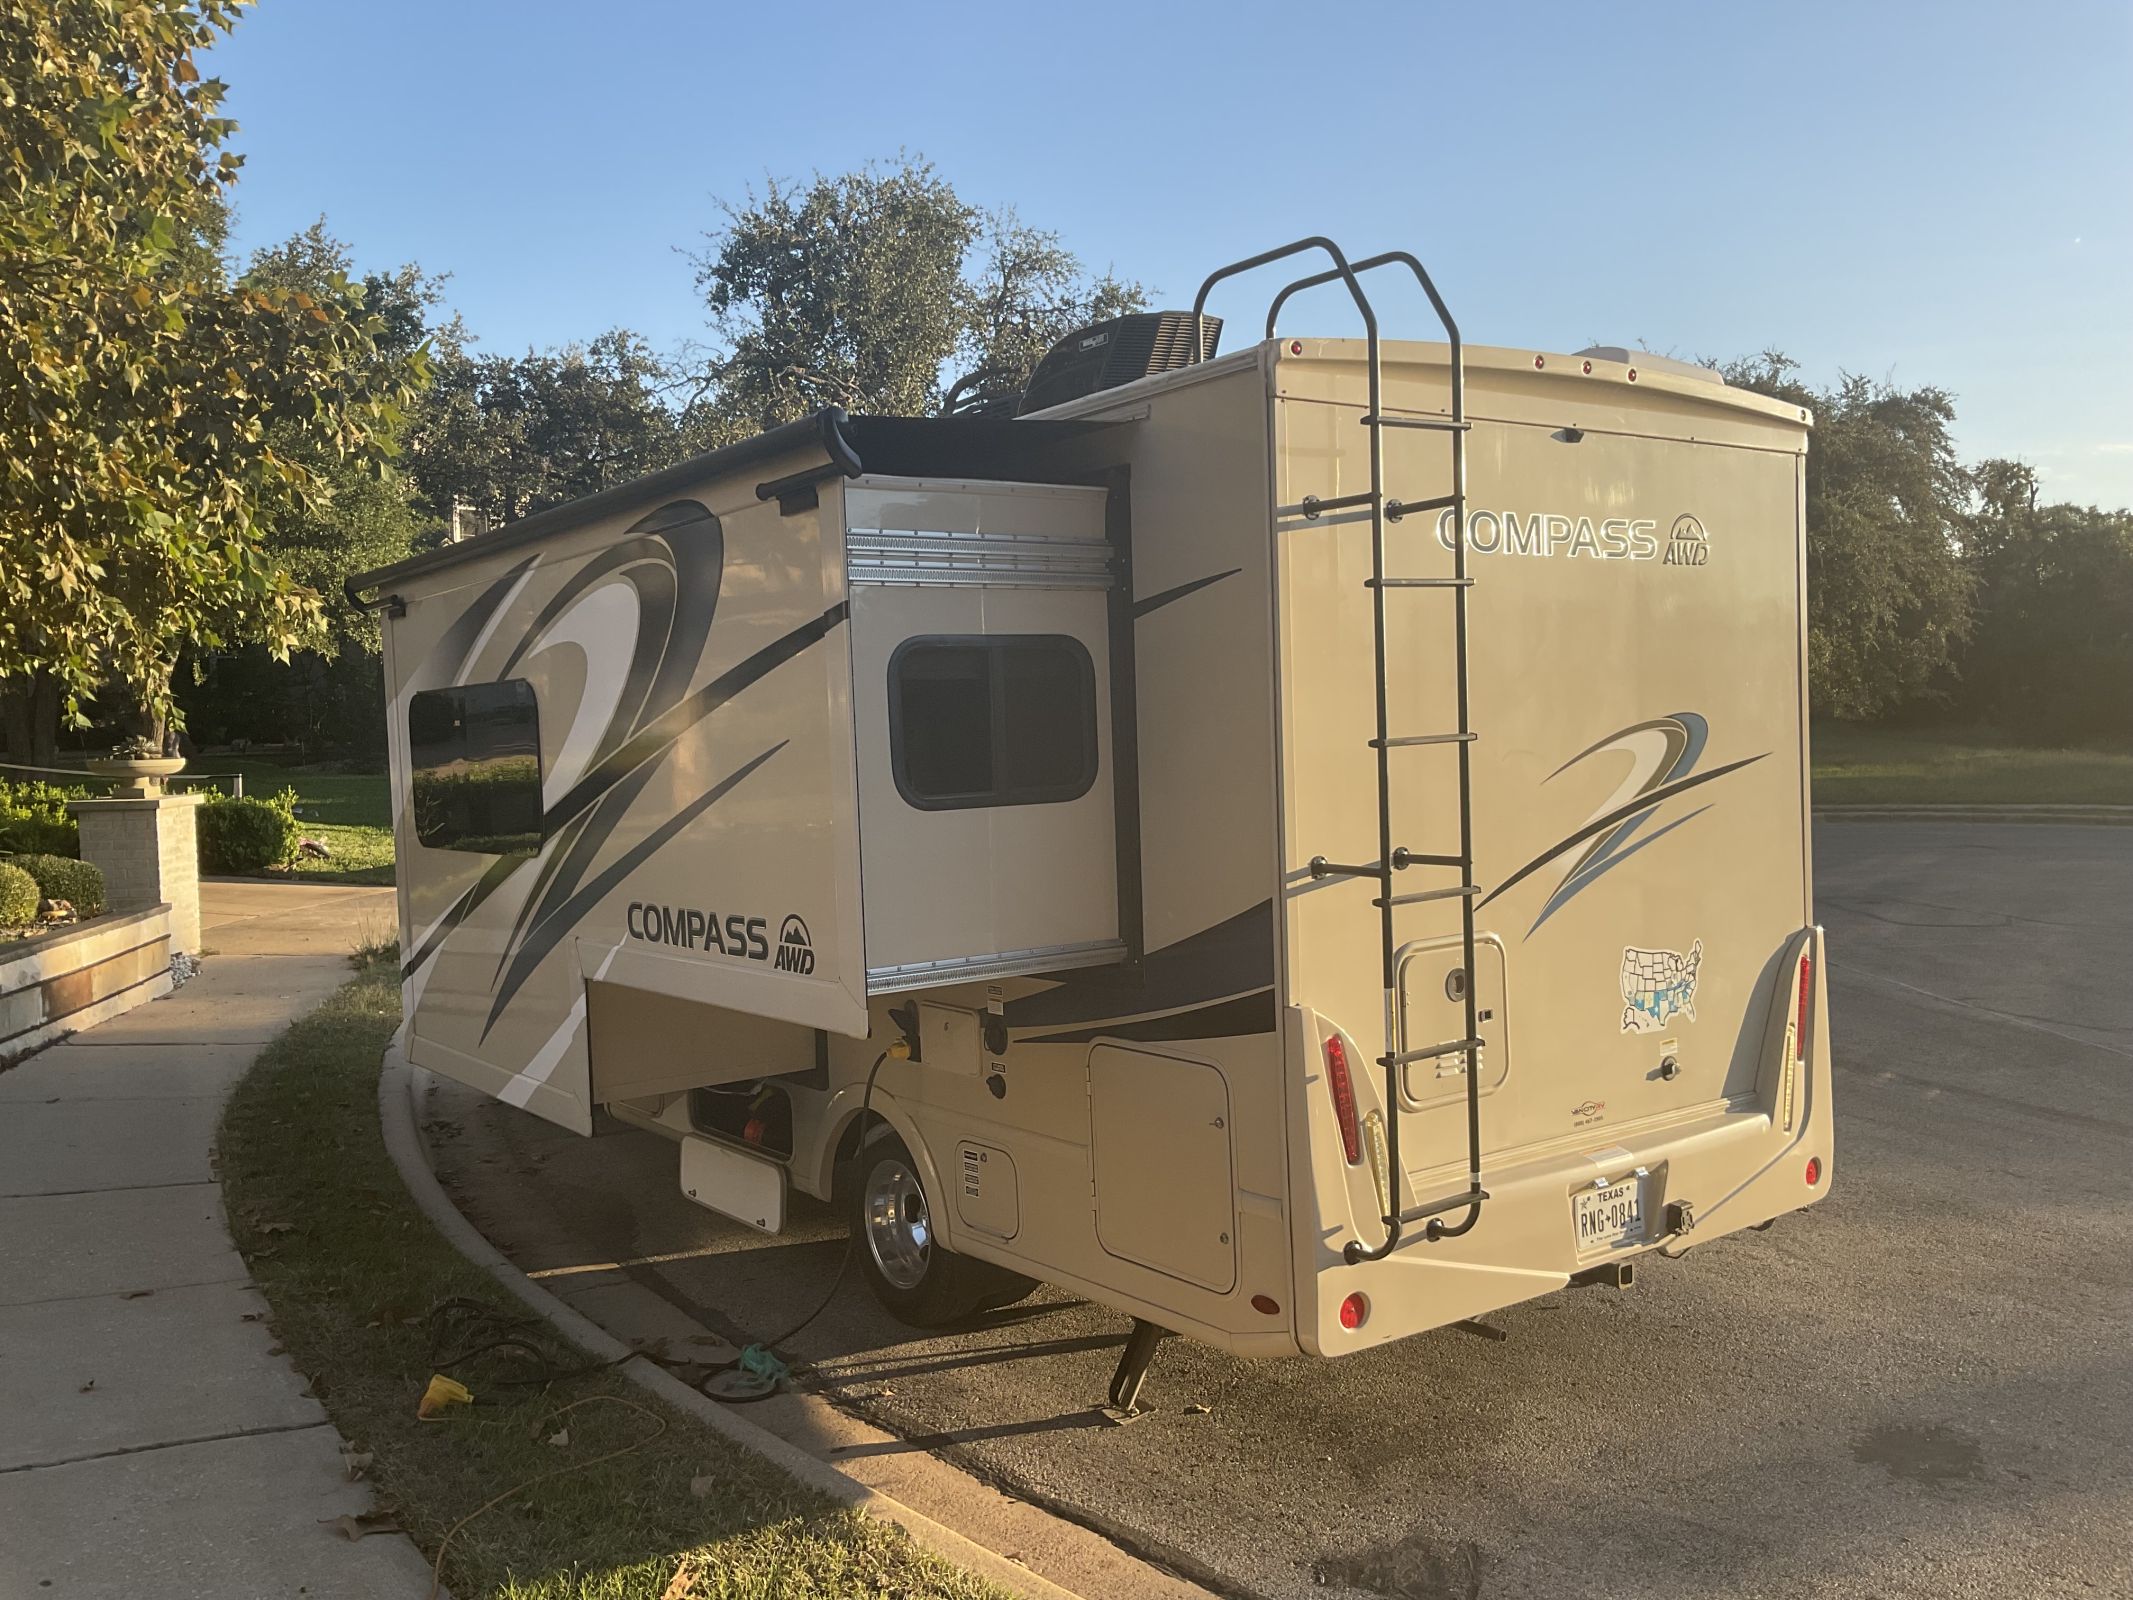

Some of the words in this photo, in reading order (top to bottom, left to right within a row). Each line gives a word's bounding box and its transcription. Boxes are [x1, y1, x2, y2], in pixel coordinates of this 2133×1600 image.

[1436, 506, 1658, 561] COMPASS
[1662, 541, 1710, 566] AWD
[627, 901, 769, 961] COMPASS
[773, 944, 815, 975] AWD
[1598, 1187, 1624, 1203] TEXAS
